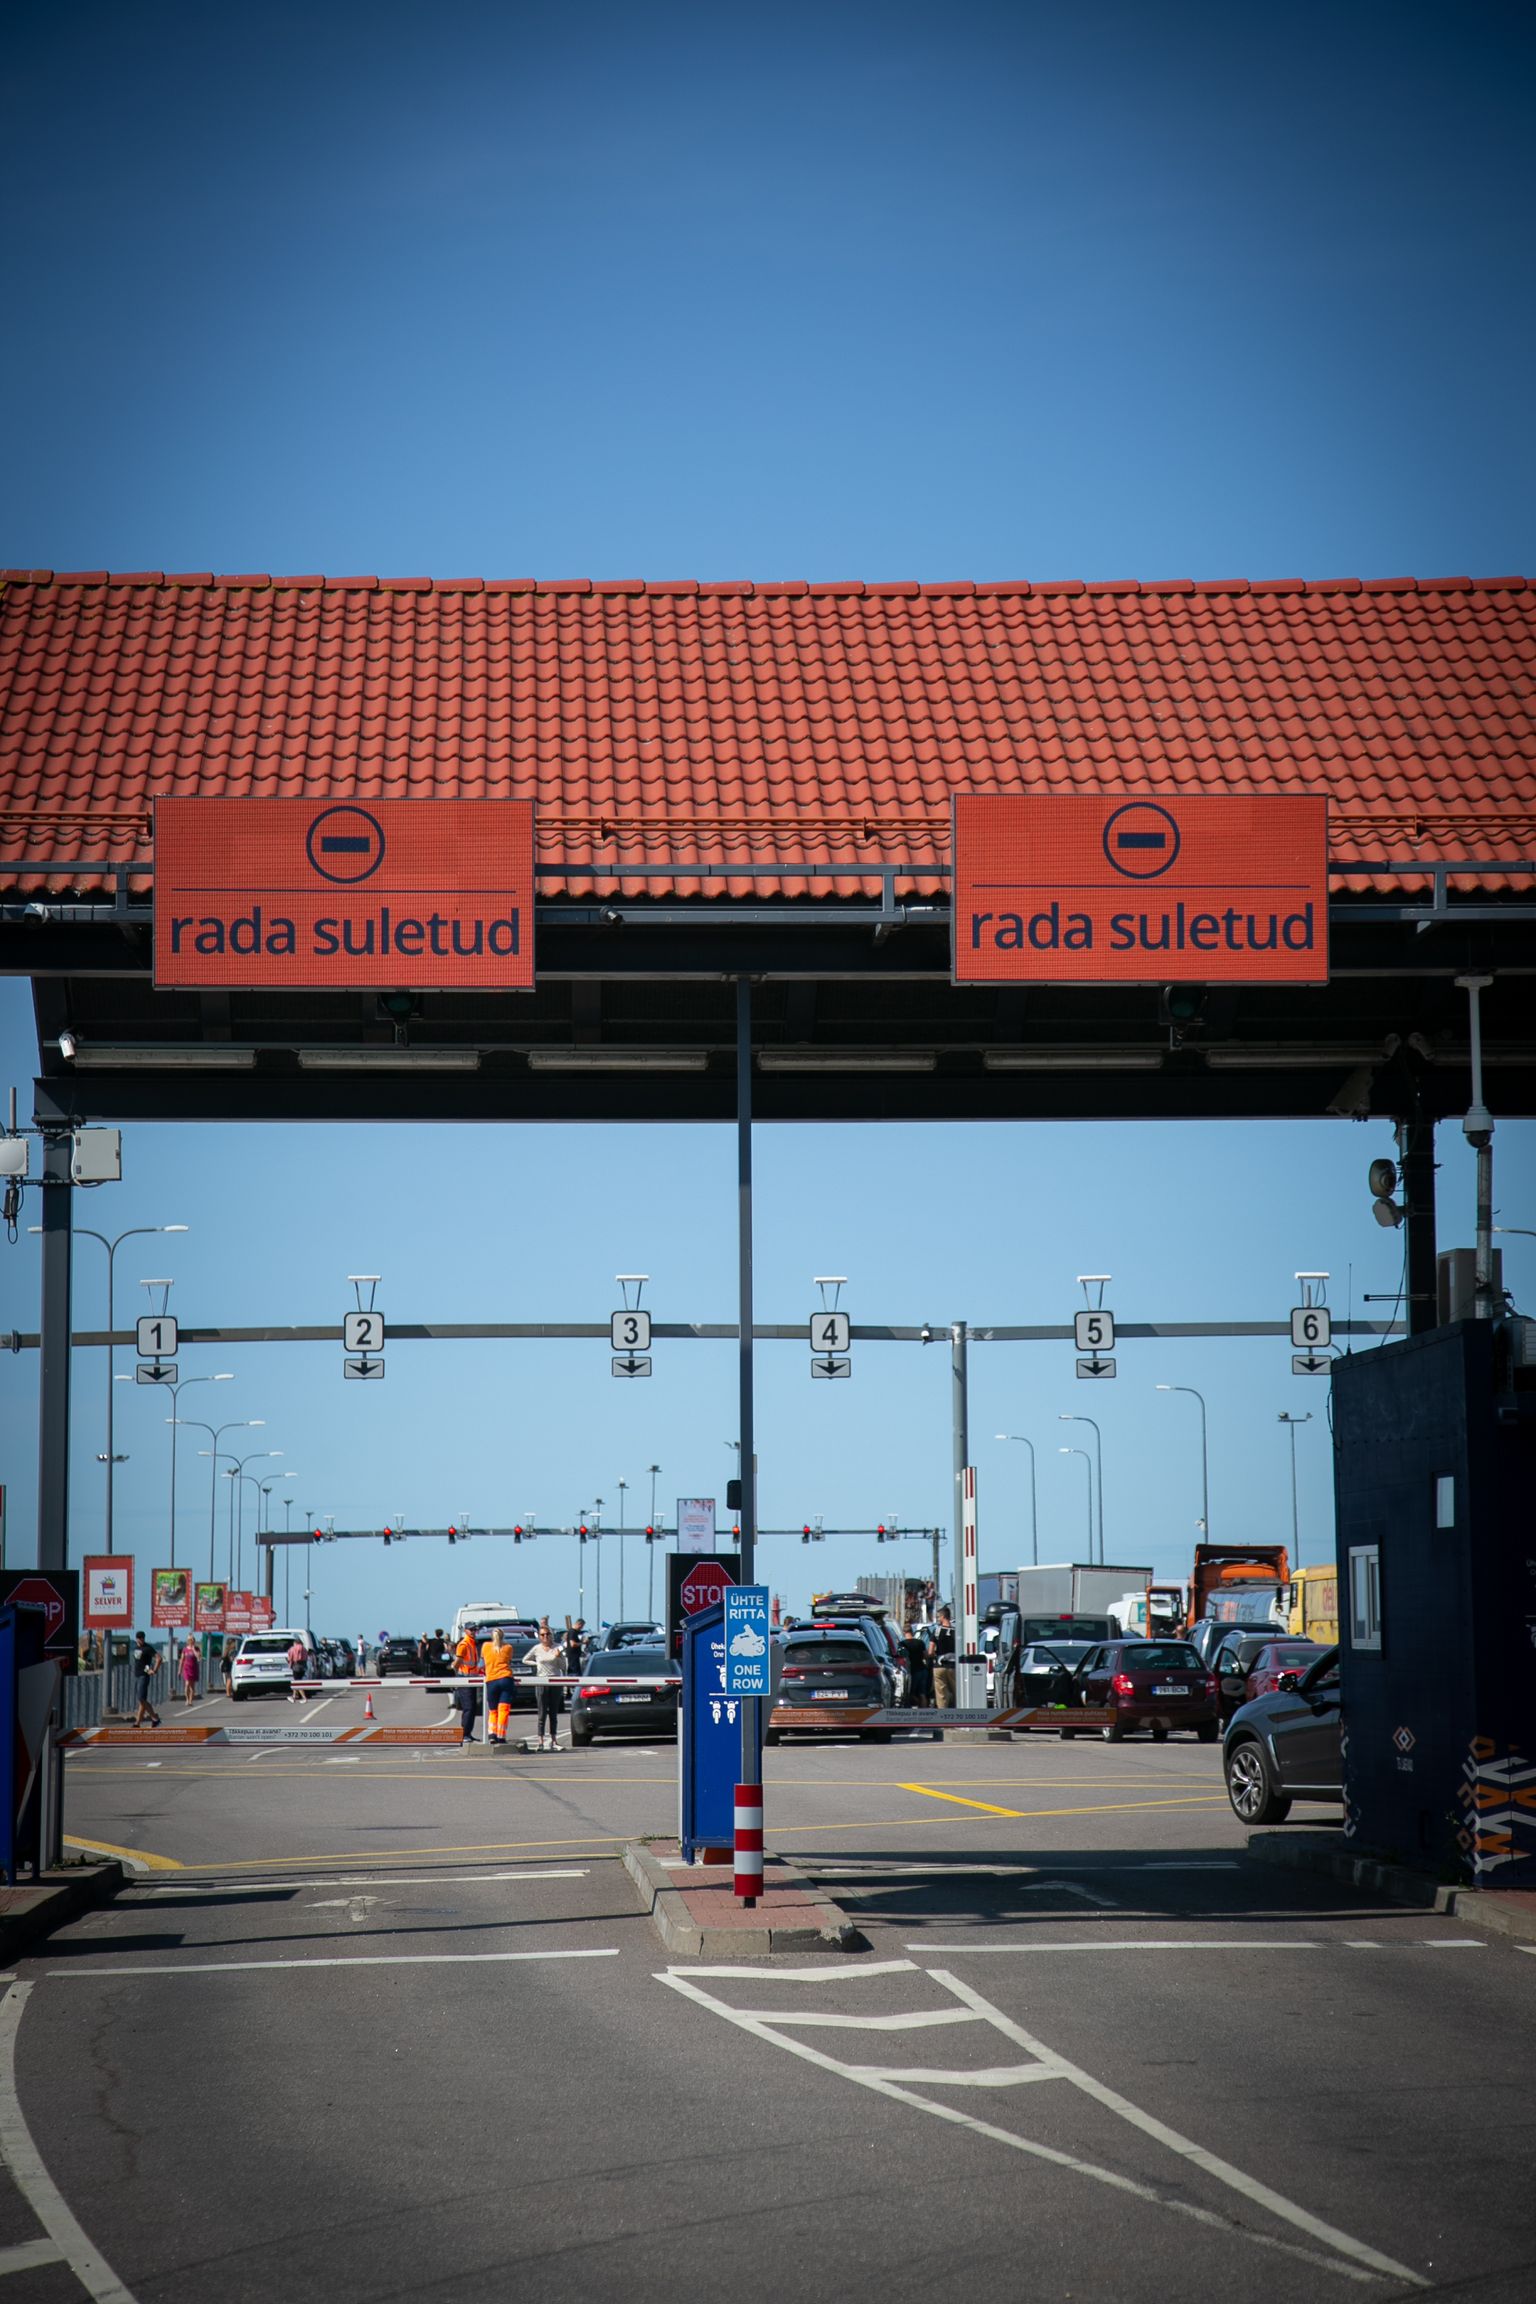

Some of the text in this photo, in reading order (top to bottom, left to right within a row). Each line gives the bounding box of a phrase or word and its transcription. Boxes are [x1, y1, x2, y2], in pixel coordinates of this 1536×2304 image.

[171, 906, 520, 955] rada suletud
[971, 902, 1314, 950] rada suletud
[151, 1323, 162, 1350] 1
[356, 1319, 371, 1345] 2
[623, 1318, 638, 1345] 3
[822, 1319, 838, 1346] 4
[1087, 1318, 1102, 1345] 5
[1304, 1314, 1318, 1341] 6
[94, 1597, 122, 1605] SELVER
[684, 1585, 725, 1604] STO
[731, 1592, 764, 1606] ÜHTE
[729, 1608, 766, 1620] RITTA
[734, 1664, 762, 1676] ONE
[732, 1678, 764, 1689] ROW
